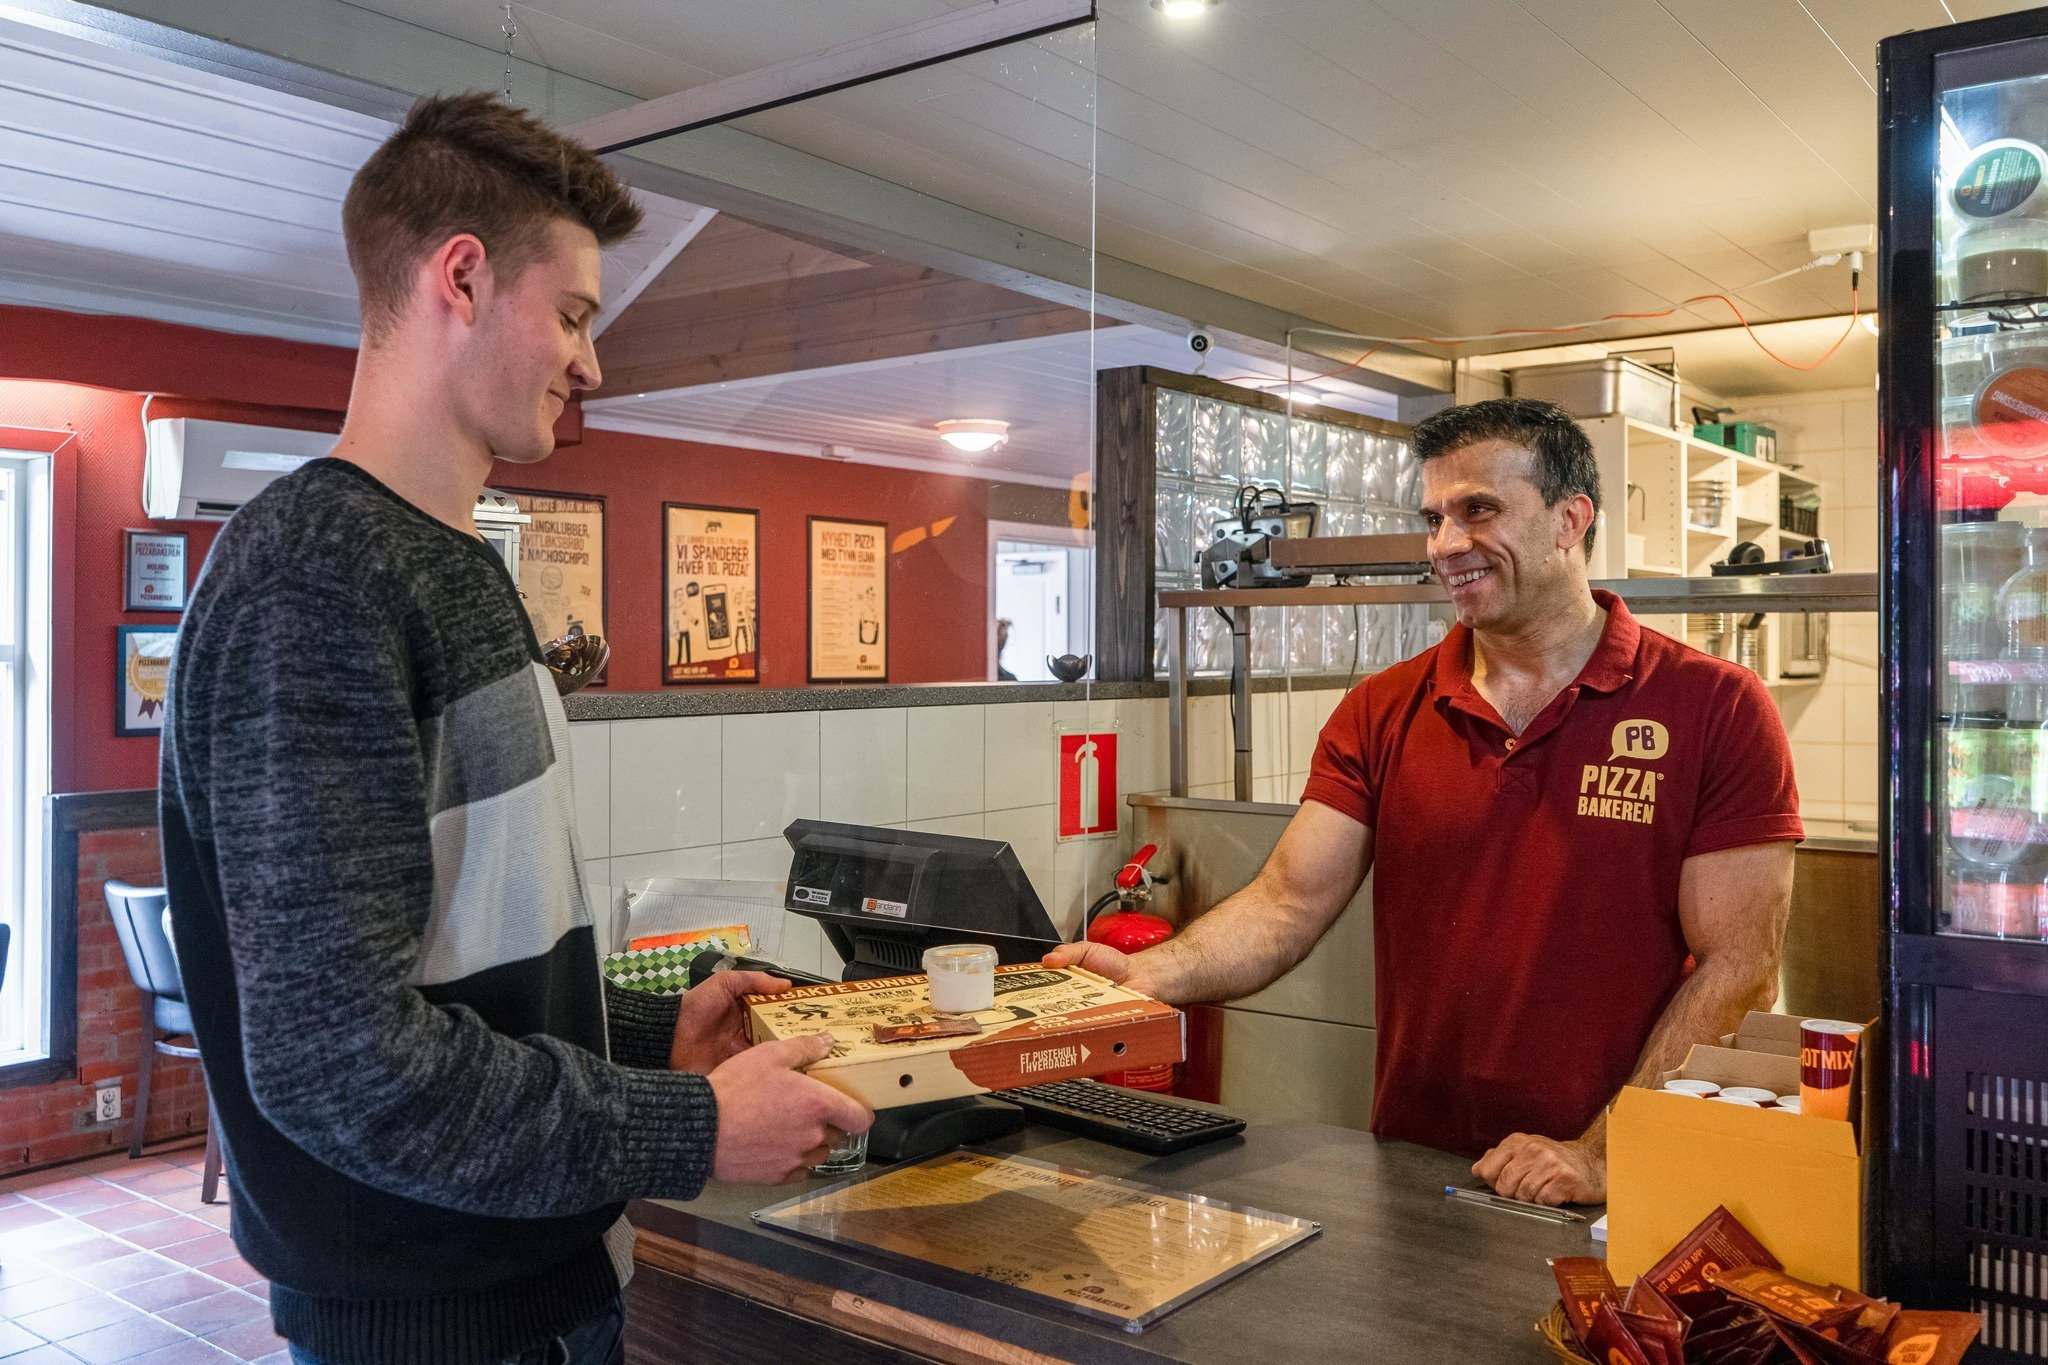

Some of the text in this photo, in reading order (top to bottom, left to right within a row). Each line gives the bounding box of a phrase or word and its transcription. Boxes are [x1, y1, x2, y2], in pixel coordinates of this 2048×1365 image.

[528, 547, 589, 565] NACHOSCHIPS!
[677, 544, 749, 562] VI SPANDERER
[677, 560, 704, 575] HVER
[722, 562, 750, 577] PIZZA!
[1625, 725, 1656, 752] PB
[1580, 764, 1656, 803] PIZZA
[1577, 796, 1655, 825] BAKEREN
[858, 975, 929, 992] BUNNE
[1026, 1055, 1077, 1073] HVERDAGEN
[1821, 1049, 1854, 1070] MIX
